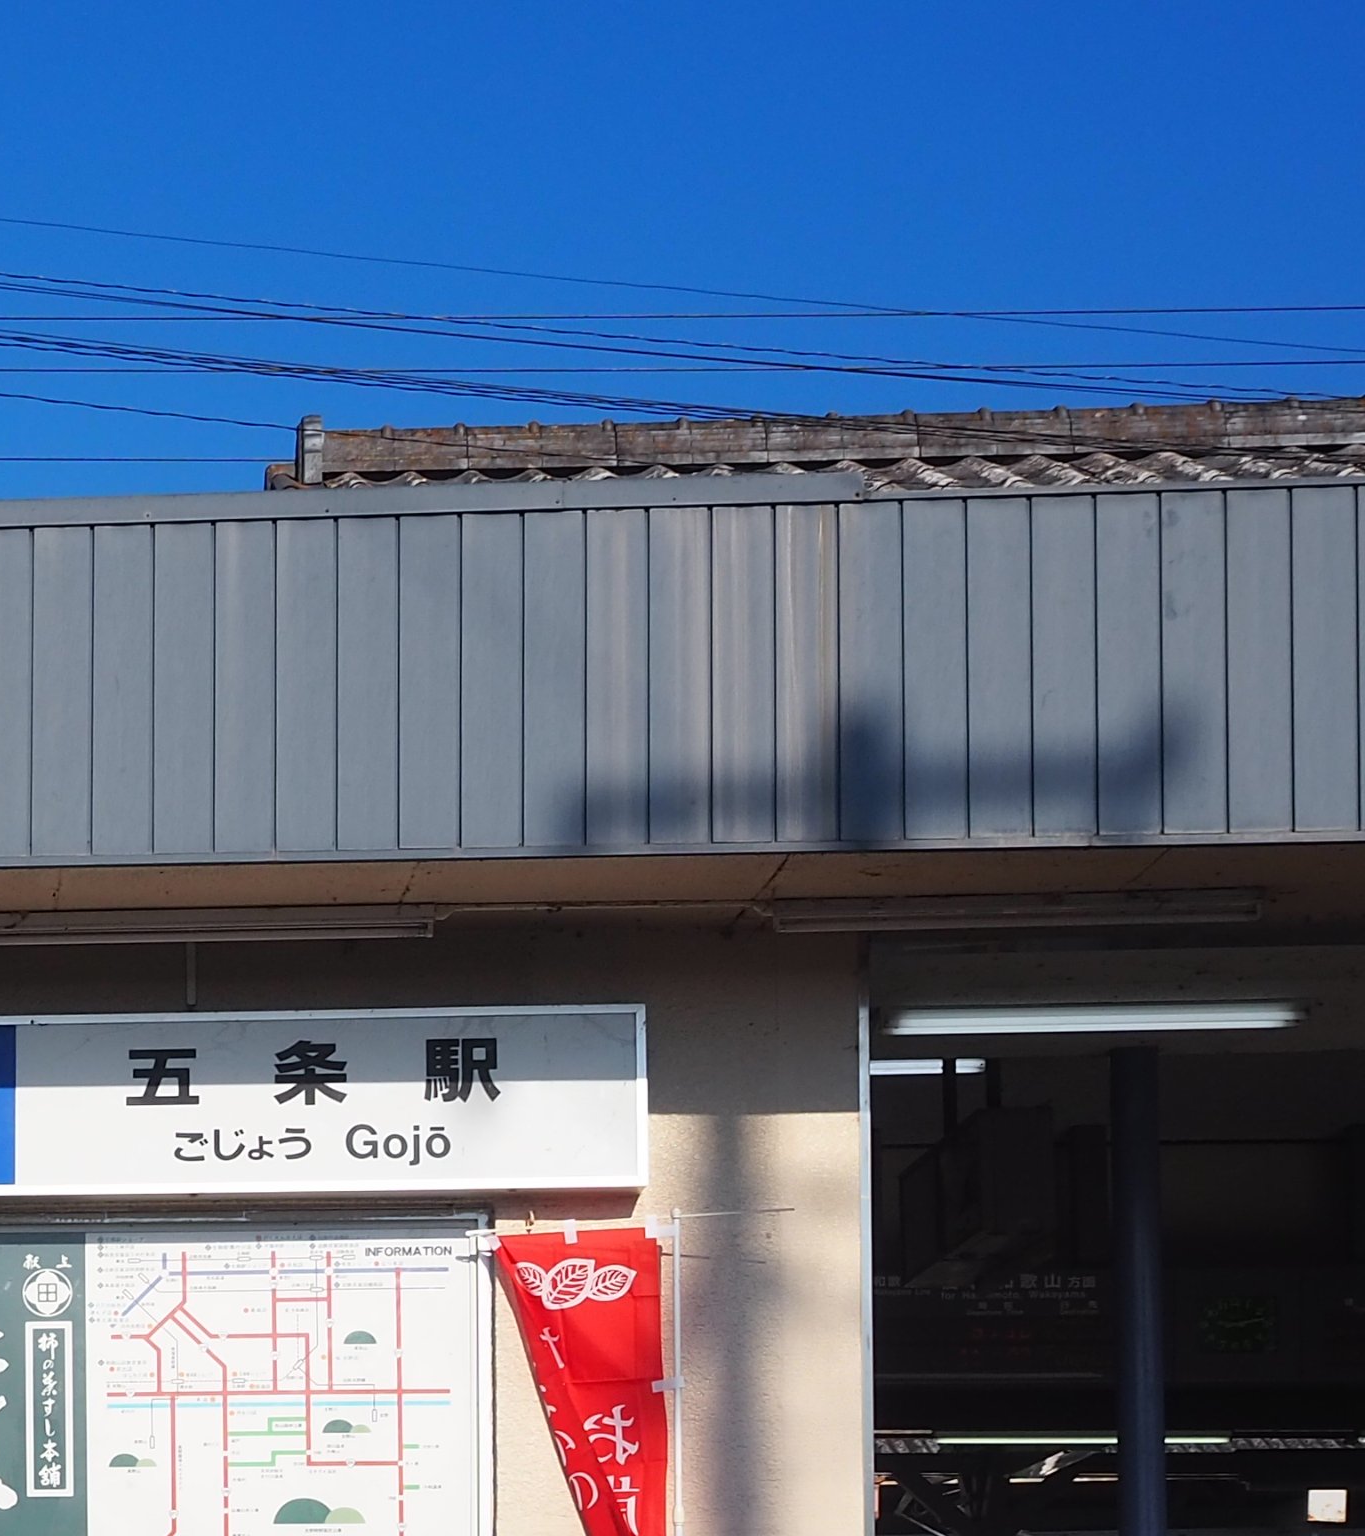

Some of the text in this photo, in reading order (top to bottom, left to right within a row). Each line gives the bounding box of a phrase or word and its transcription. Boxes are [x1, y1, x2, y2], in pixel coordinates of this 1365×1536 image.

[126, 1037, 502, 1106] 五条駅
[173, 1124, 452, 1166] ごじょう Gojō
[365, 1246, 453, 1257] INFORMATION
